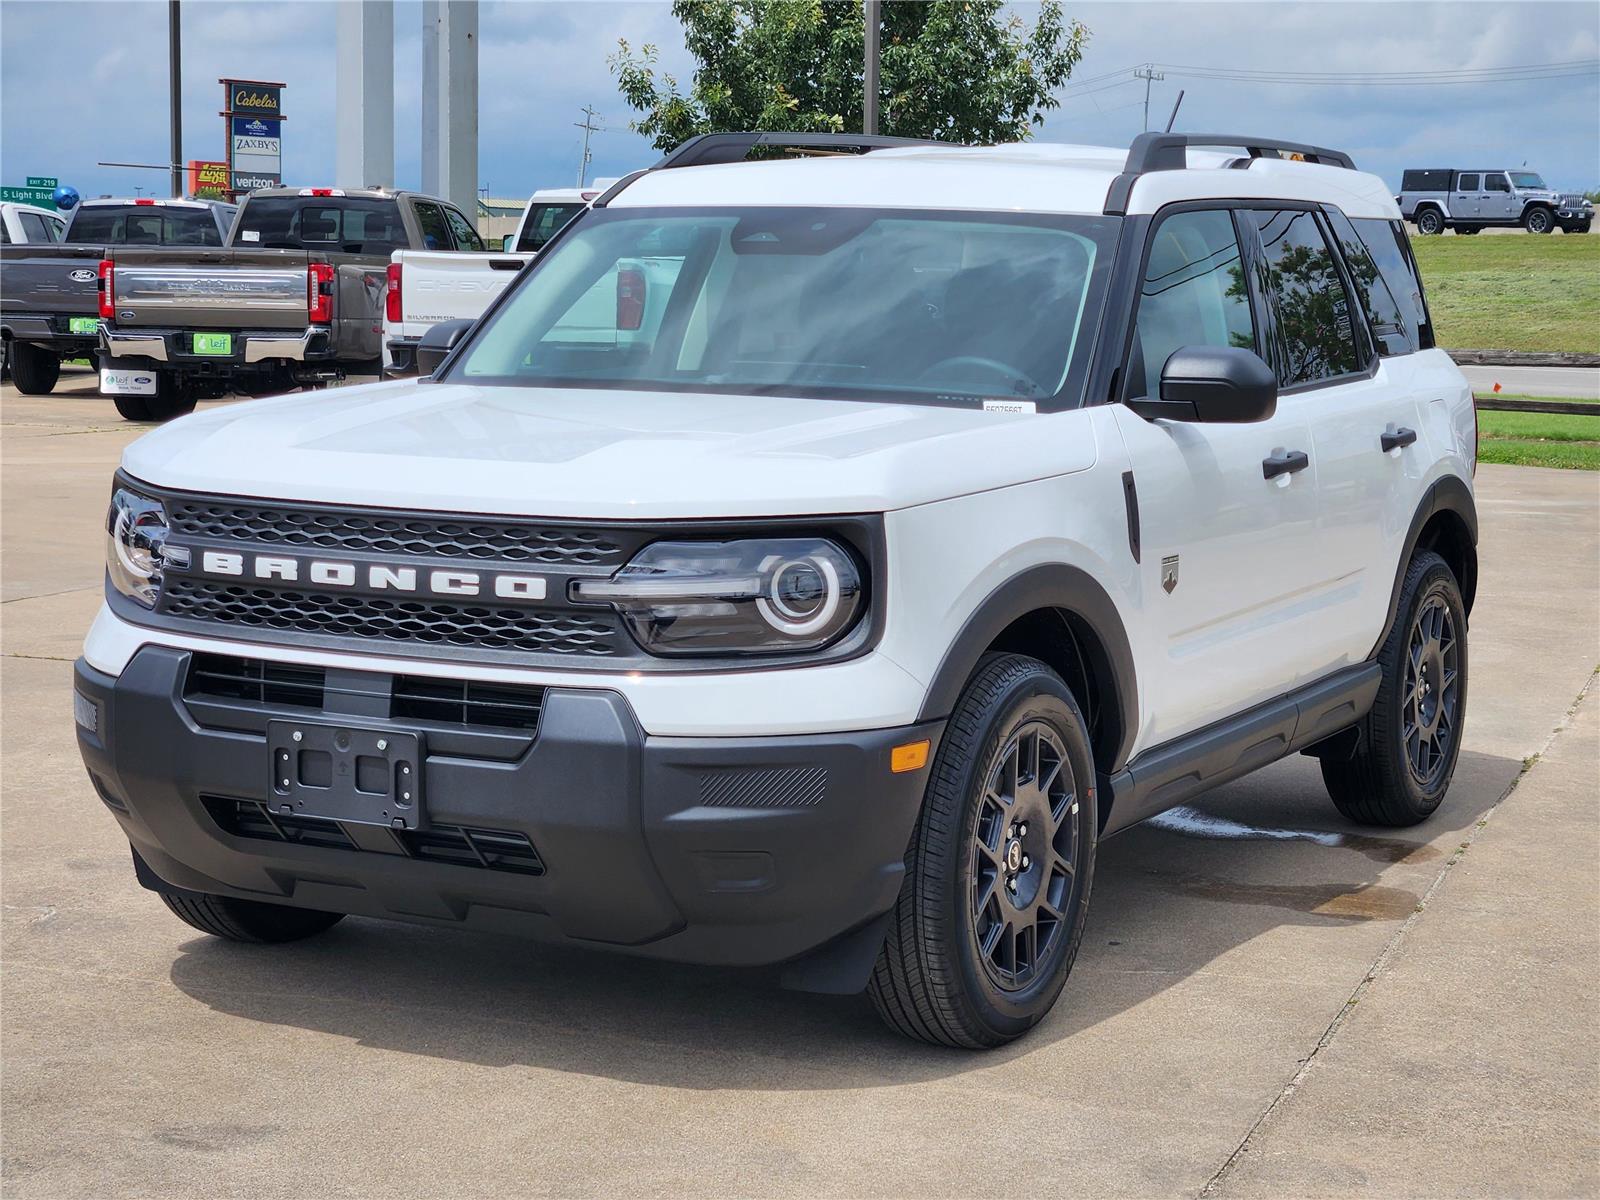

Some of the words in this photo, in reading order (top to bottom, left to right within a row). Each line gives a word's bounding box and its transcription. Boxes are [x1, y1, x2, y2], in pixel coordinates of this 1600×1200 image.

[236, 139, 278, 152] ZAXBY'S
[236, 176, 274, 189] verizon
[11, 191, 32, 200] Light
[36, 192, 53, 200] Blvd
[203, 551, 546, 599] BRONCO
